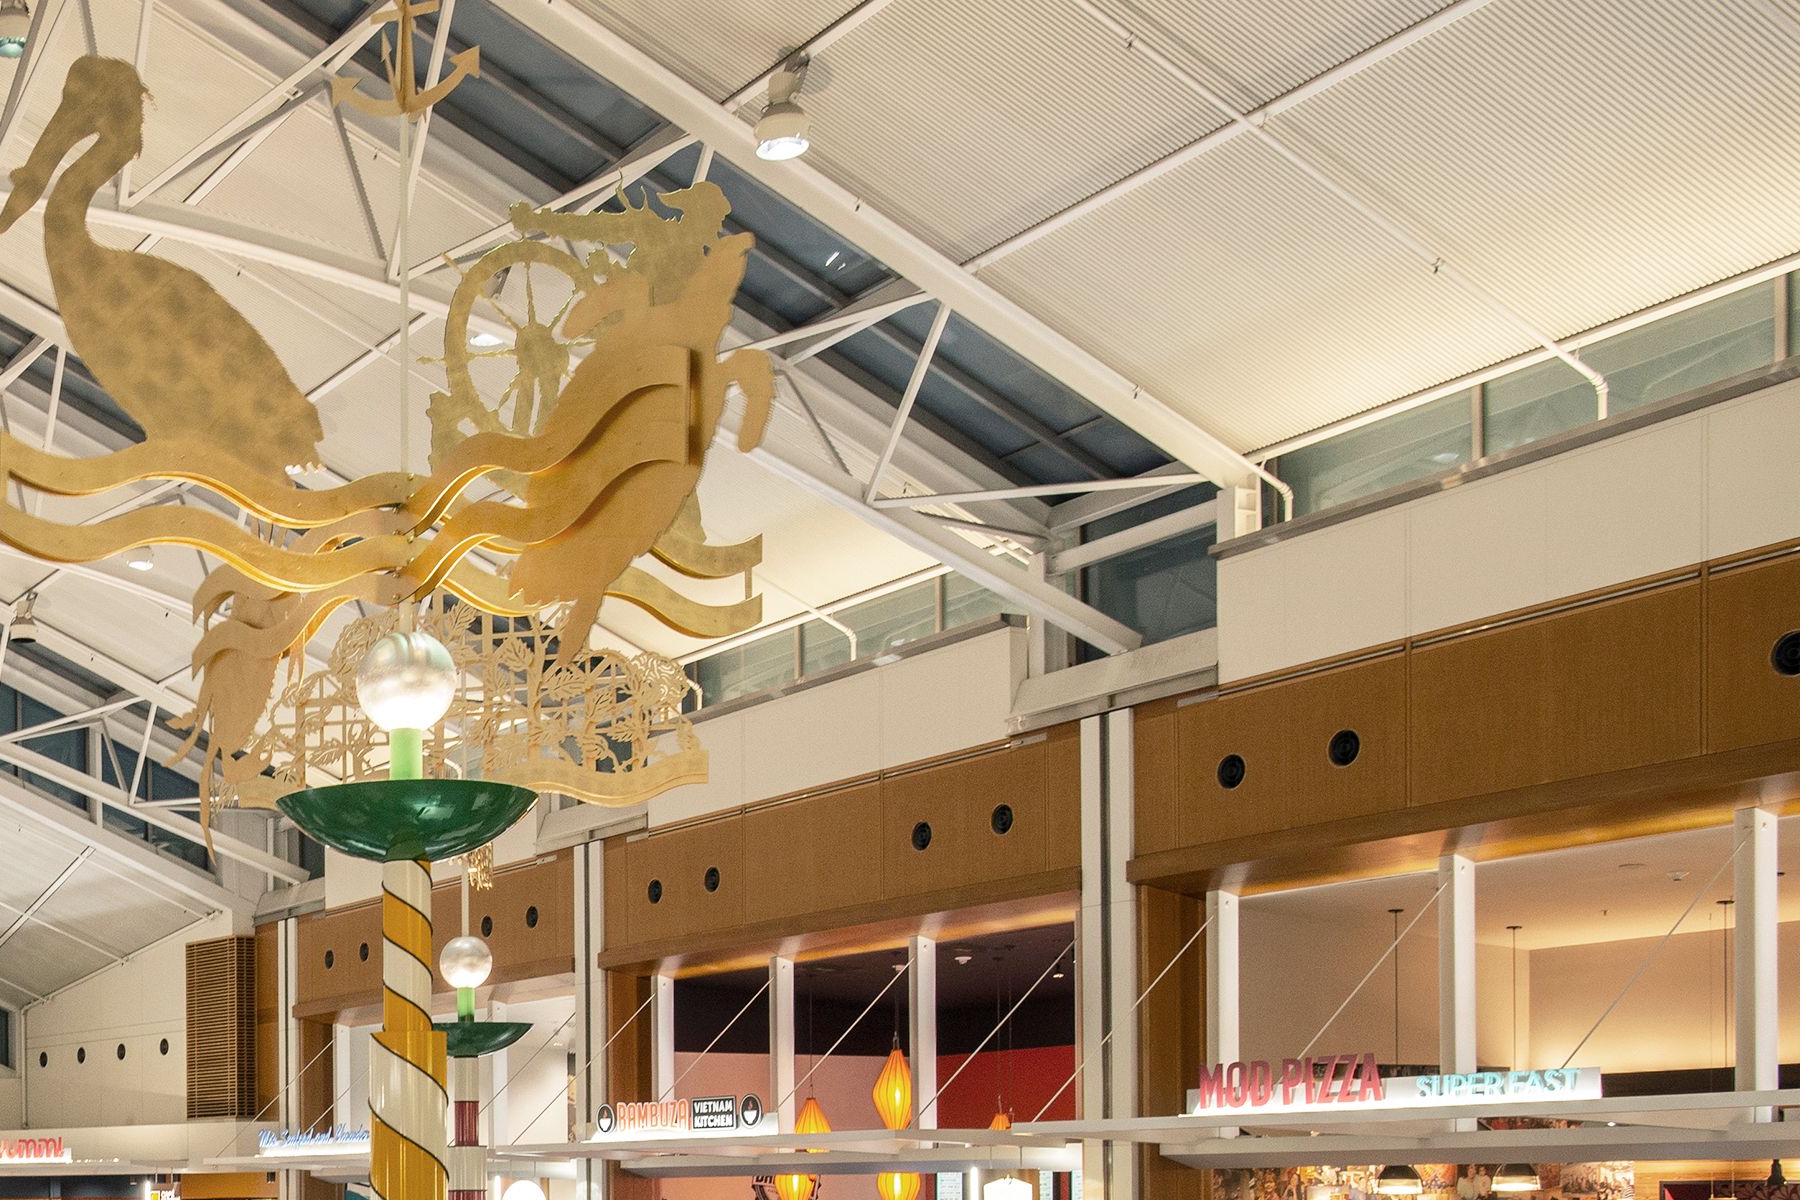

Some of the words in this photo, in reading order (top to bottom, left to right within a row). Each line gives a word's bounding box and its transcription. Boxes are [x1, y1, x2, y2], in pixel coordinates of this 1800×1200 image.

[1199, 1060, 1274, 1110] MOD
[1282, 1053, 1385, 1104] PIZZA
[1416, 1073, 1506, 1099] SUPER
[1512, 1068, 1580, 1095] FAST
[616, 1098, 691, 1132] BAMBUZA
[693, 1114, 733, 1129] KITCHEN
[694, 1101, 733, 1113] VIETNAM
